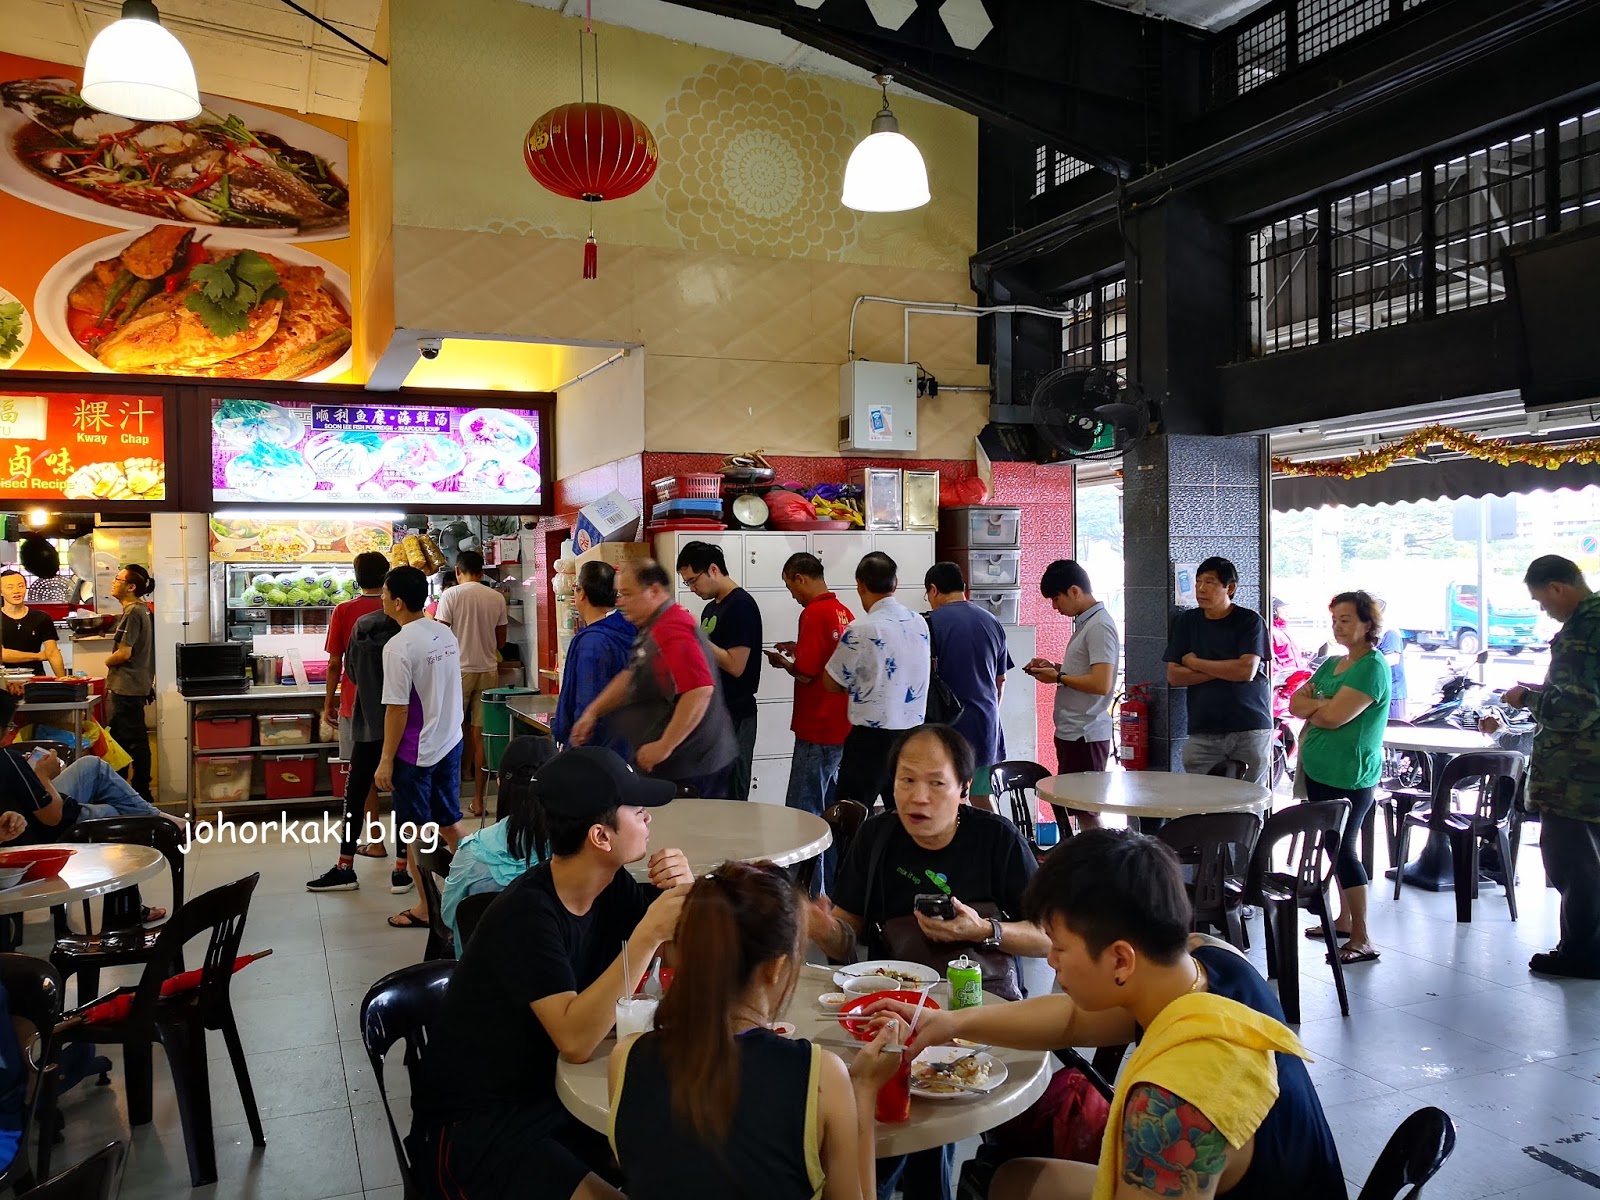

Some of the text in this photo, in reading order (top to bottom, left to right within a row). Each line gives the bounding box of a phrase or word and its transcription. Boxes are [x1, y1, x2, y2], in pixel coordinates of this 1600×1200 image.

[72, 399, 154, 433] 粿汁
[77, 433, 149, 446] Kway Chap
